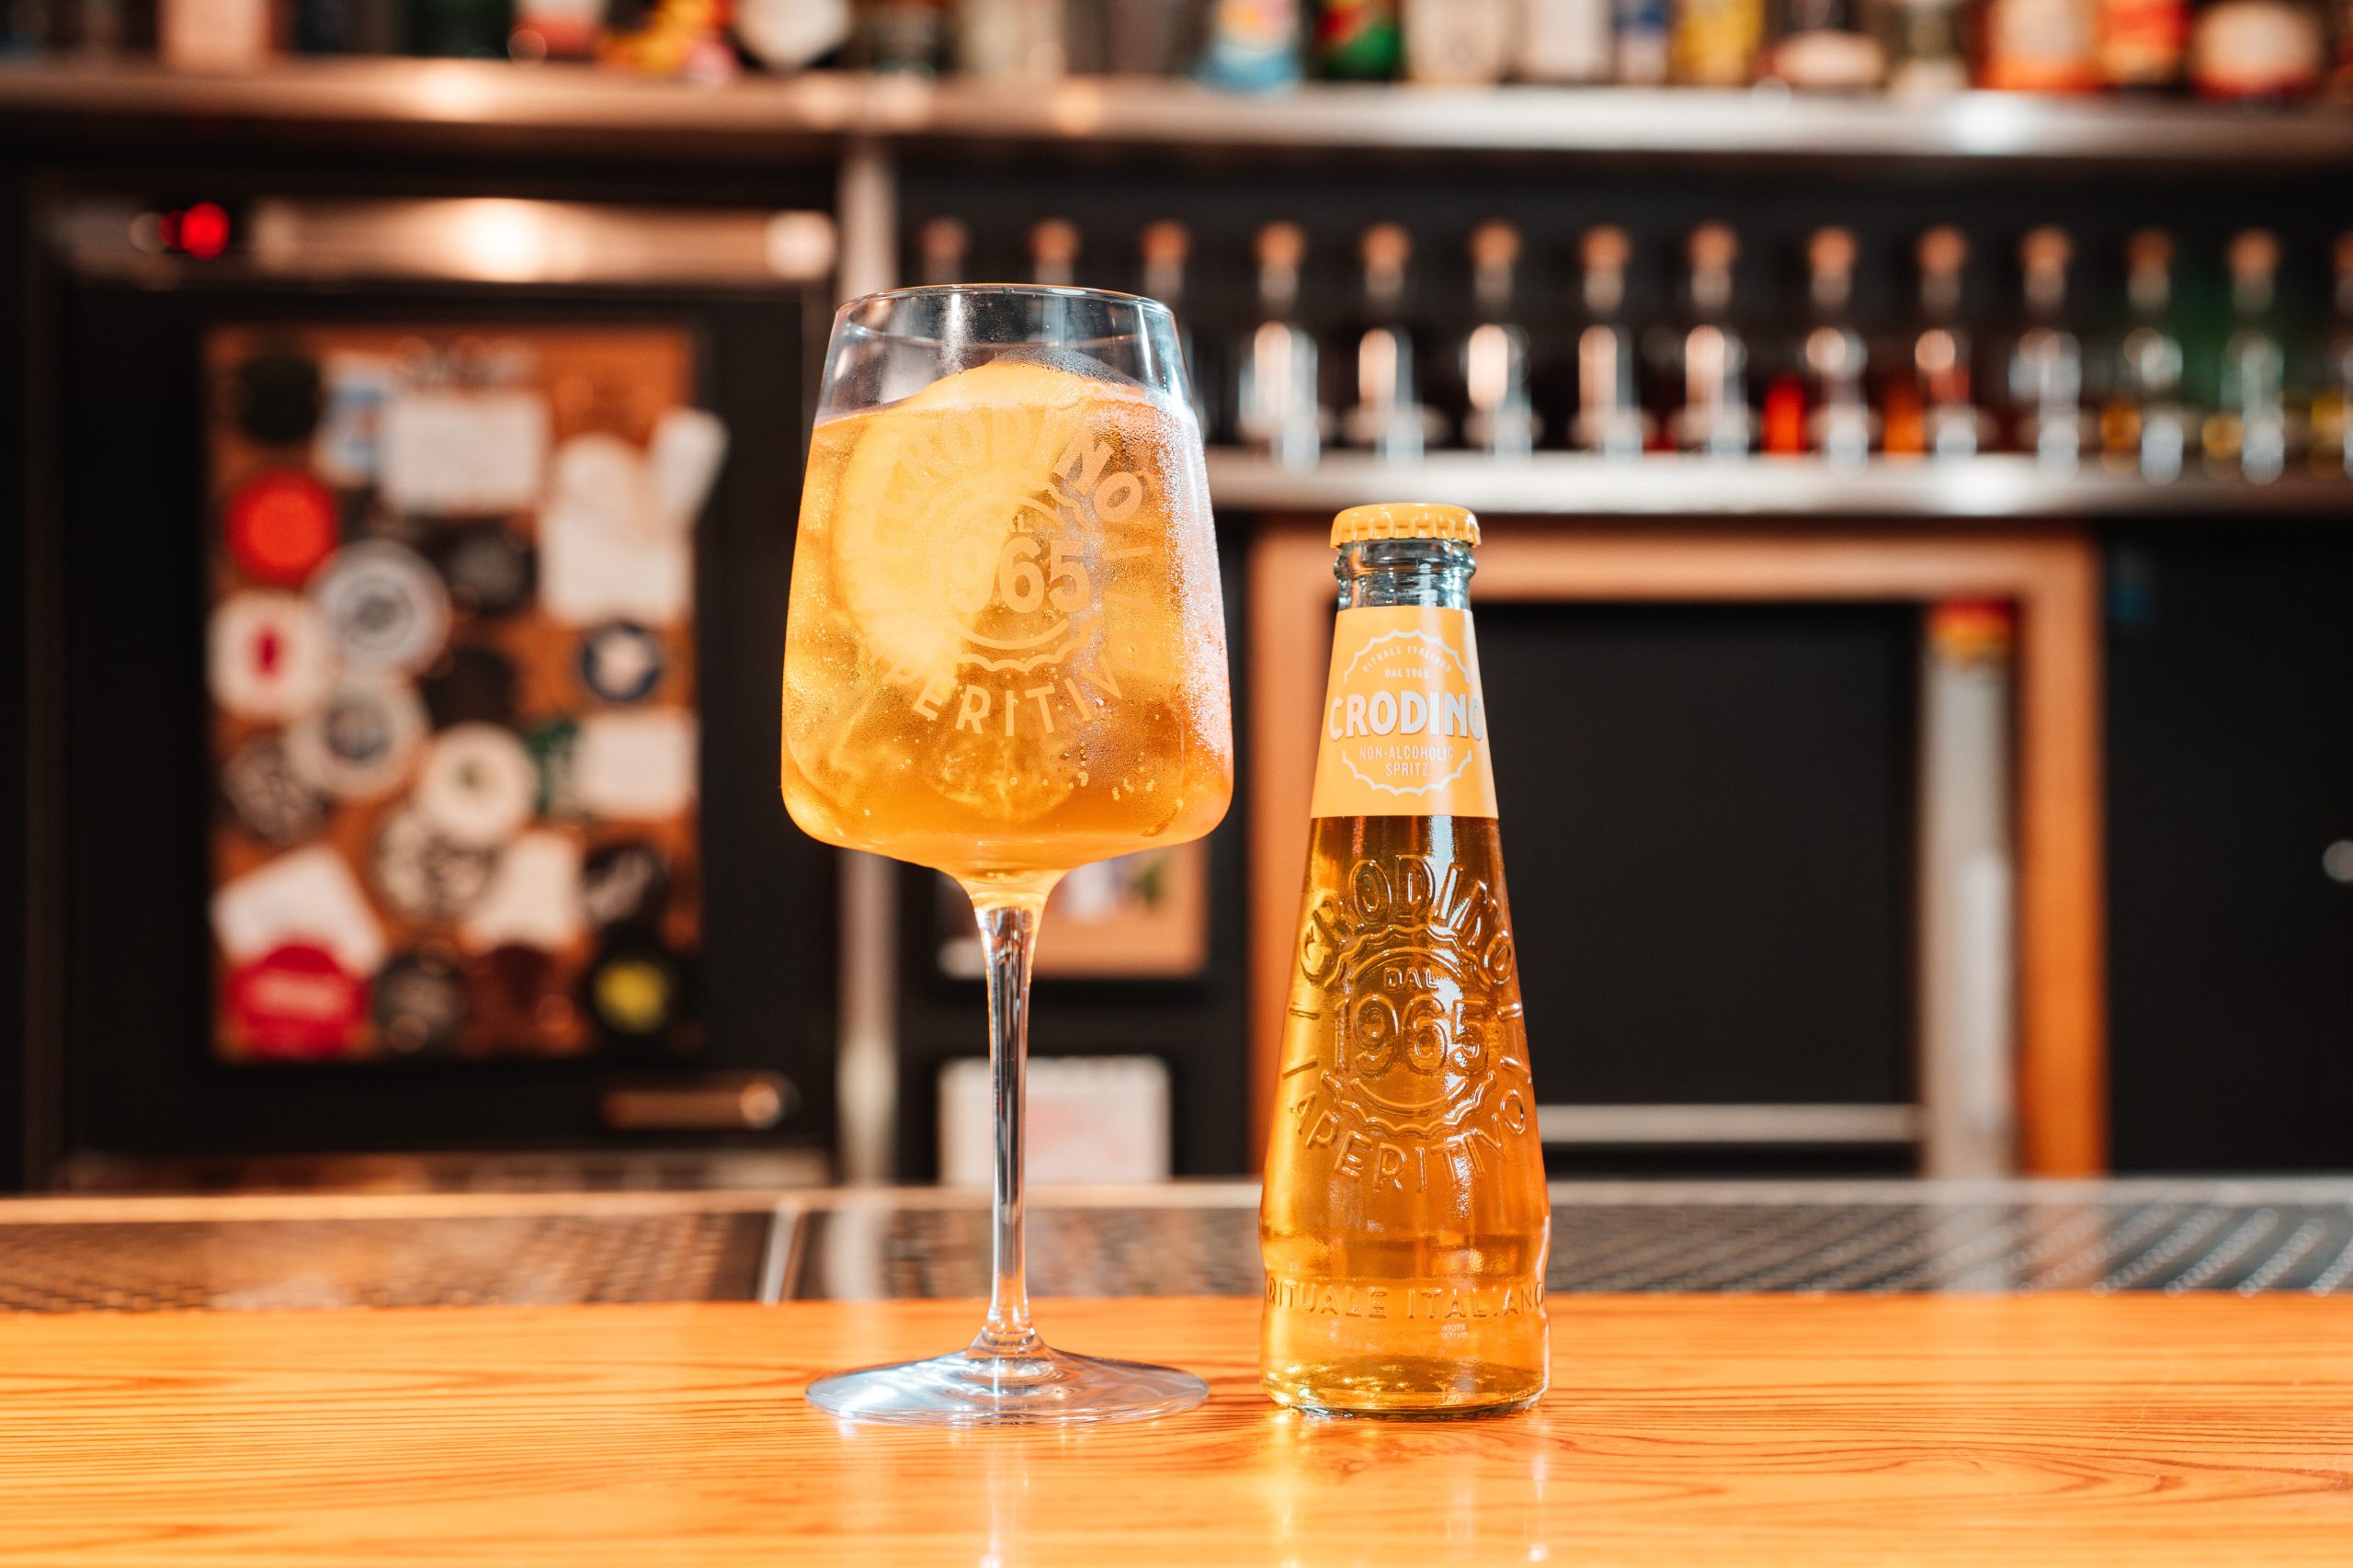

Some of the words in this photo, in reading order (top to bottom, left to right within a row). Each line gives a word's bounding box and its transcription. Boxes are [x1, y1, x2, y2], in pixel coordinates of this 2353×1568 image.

[930, 536, 1091, 614] 965
[1384, 667, 1404, 678] DAL
[1328, 690, 1483, 741] CRODINO
[1359, 745, 1454, 761] NON-ALCOHOLIC
[1385, 762, 1428, 777] SPRITZ
[1299, 854, 1514, 985] CRODINO
[1382, 966, 1438, 992] DAL
[1334, 994, 1494, 1076] 1965
